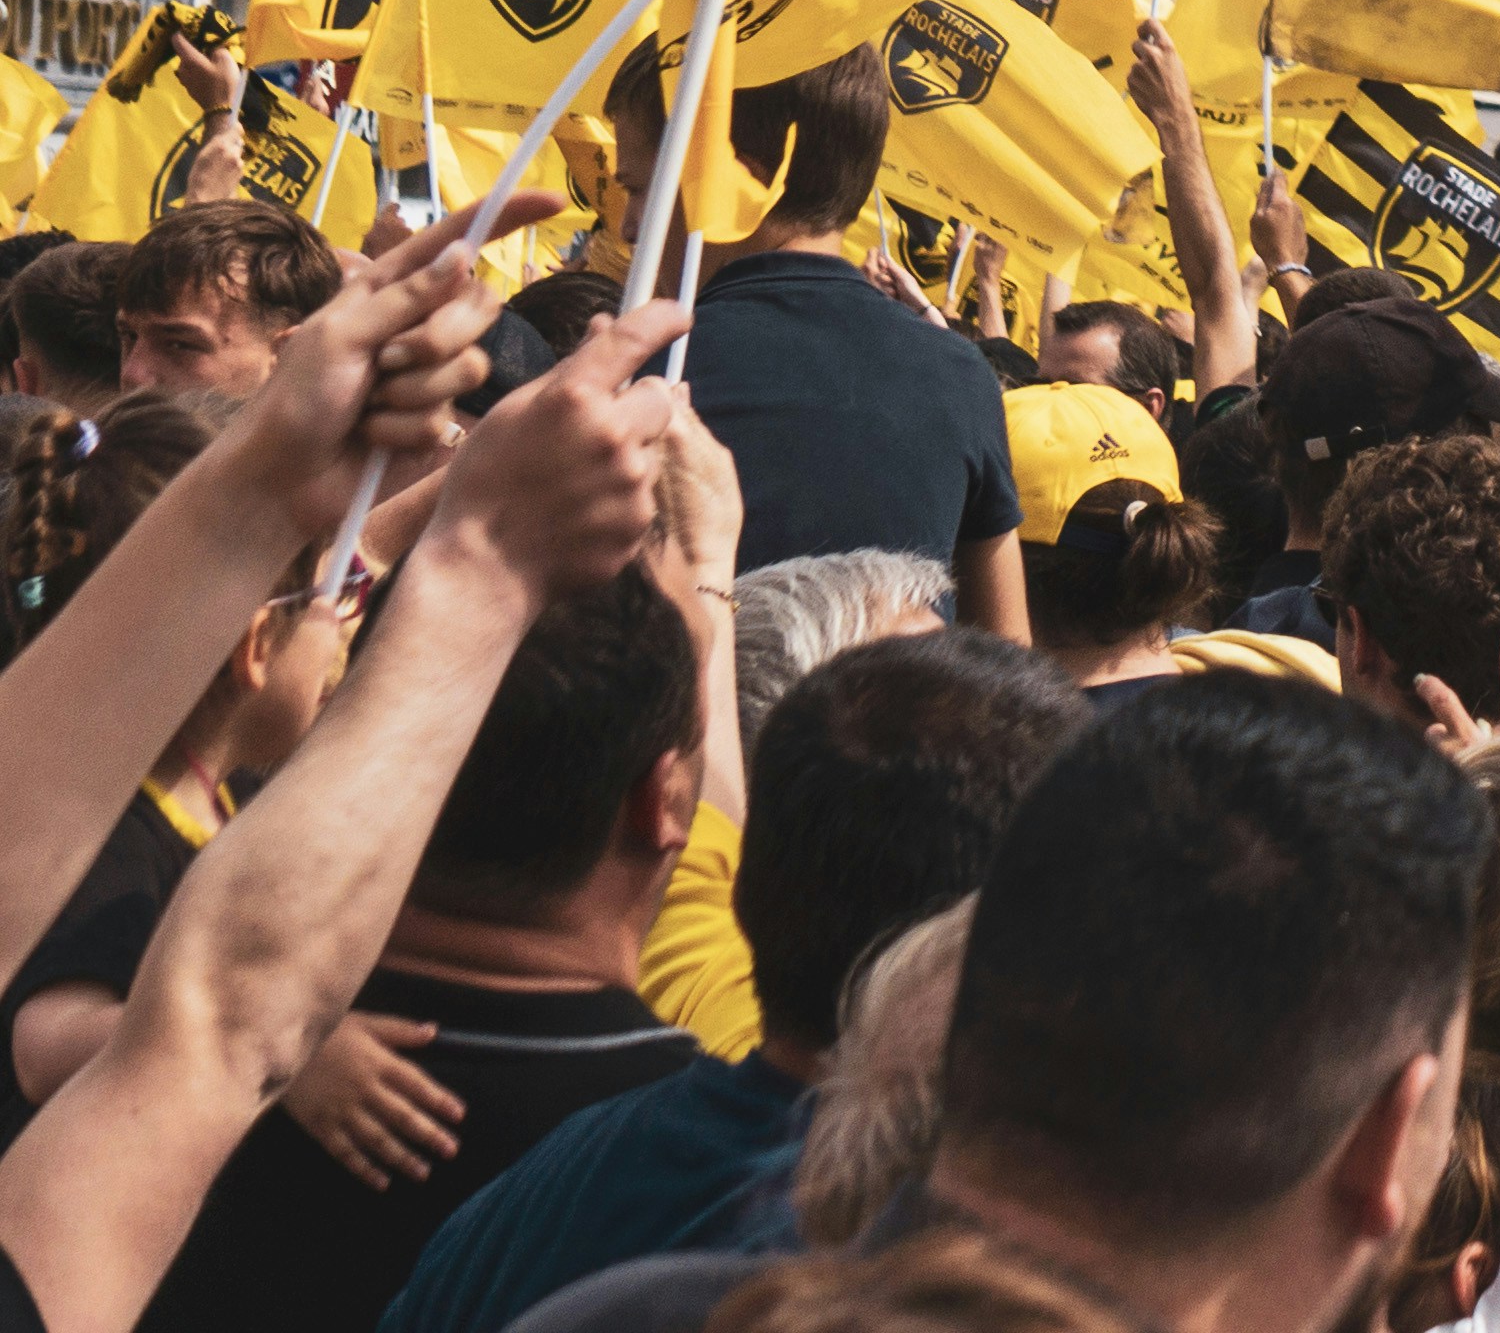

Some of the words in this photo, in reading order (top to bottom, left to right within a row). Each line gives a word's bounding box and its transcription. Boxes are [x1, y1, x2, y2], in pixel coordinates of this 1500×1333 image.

[904, 5, 997, 73] ROCHELAIS
[939, 9, 982, 40] STADE
[1445, 166, 1498, 209] STADE
[1089, 448, 1130, 463] adidas
